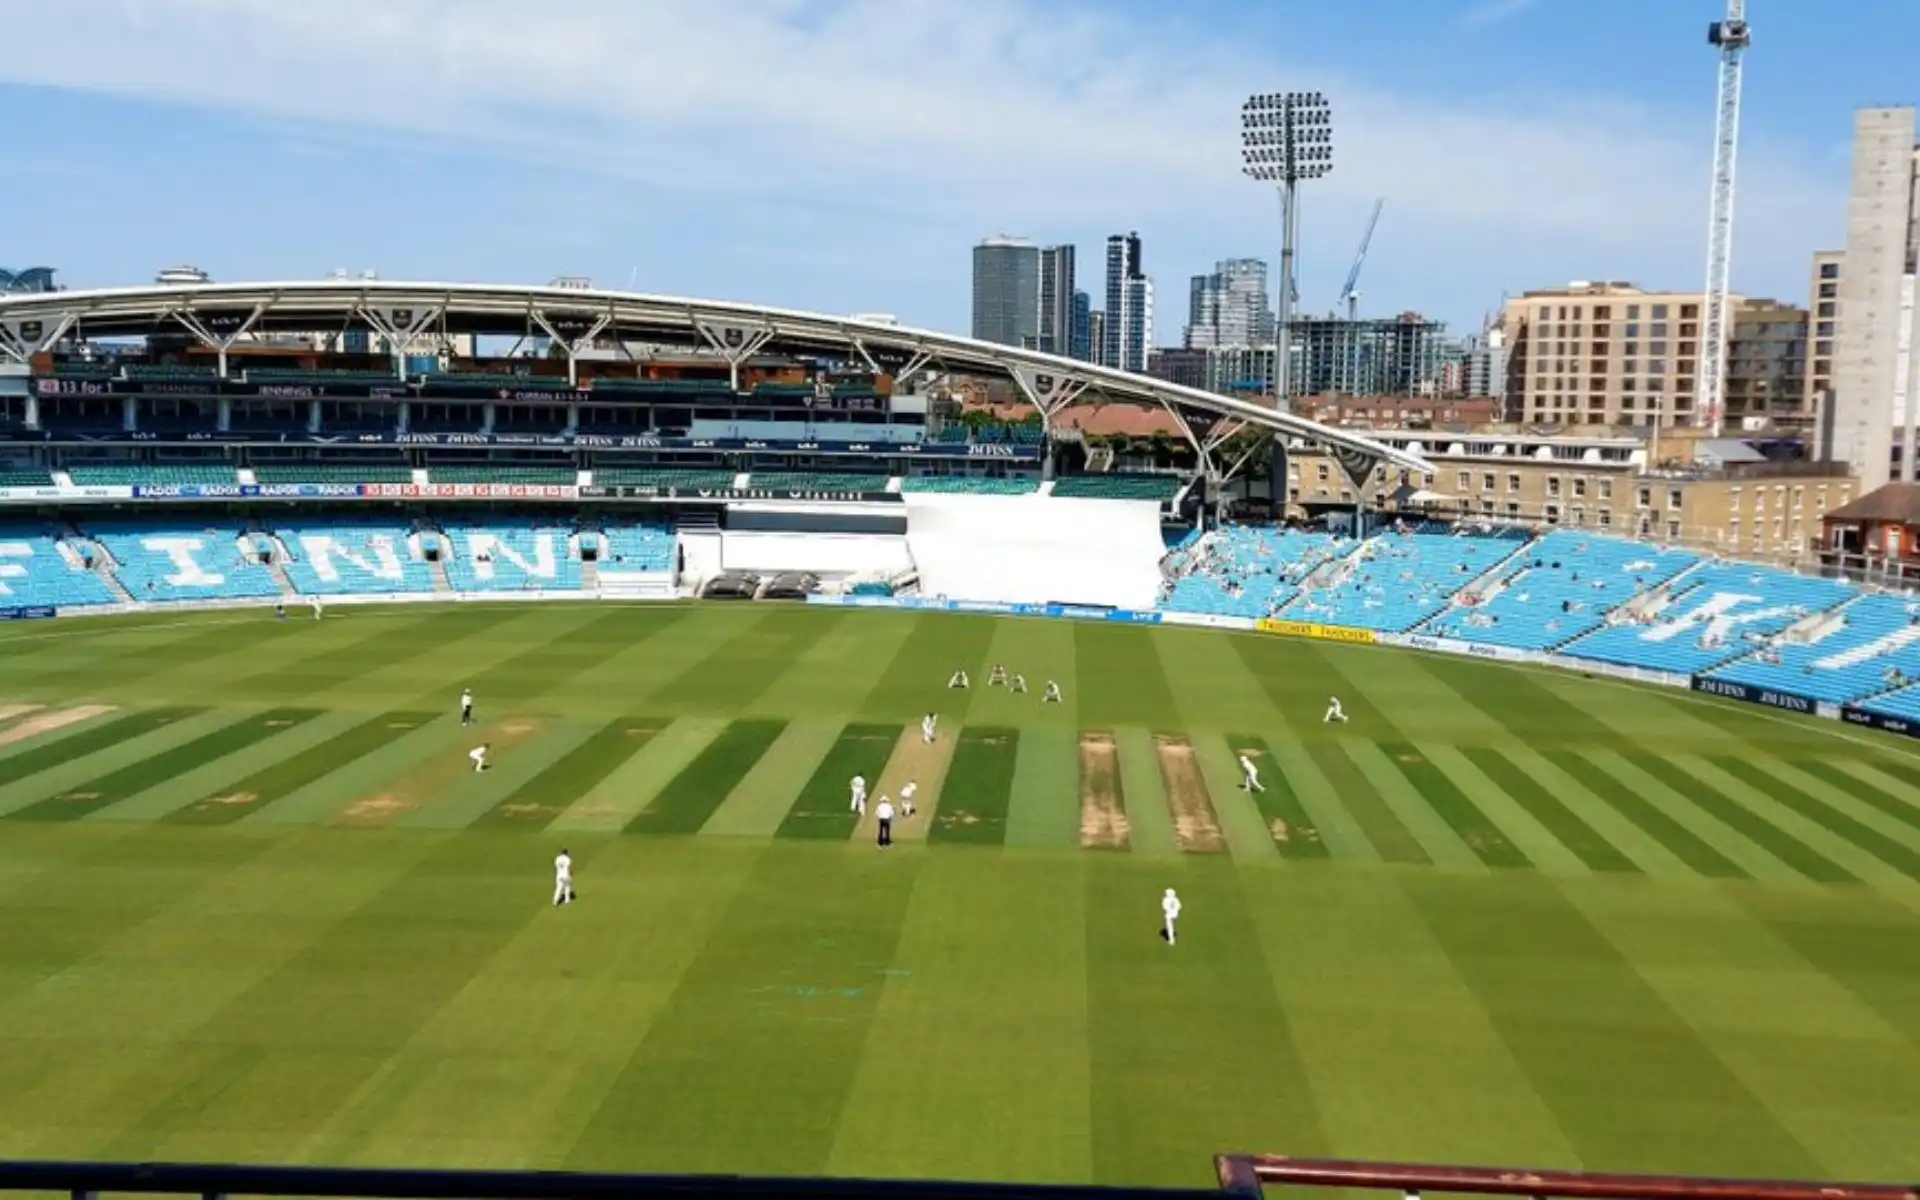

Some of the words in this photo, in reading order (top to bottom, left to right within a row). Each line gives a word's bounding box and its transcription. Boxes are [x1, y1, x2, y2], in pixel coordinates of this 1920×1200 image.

[62, 380, 77, 394] 13
[81, 380, 104, 395] for
[1717, 682, 1747, 698] FINN
[1778, 694, 1809, 711] FINN
